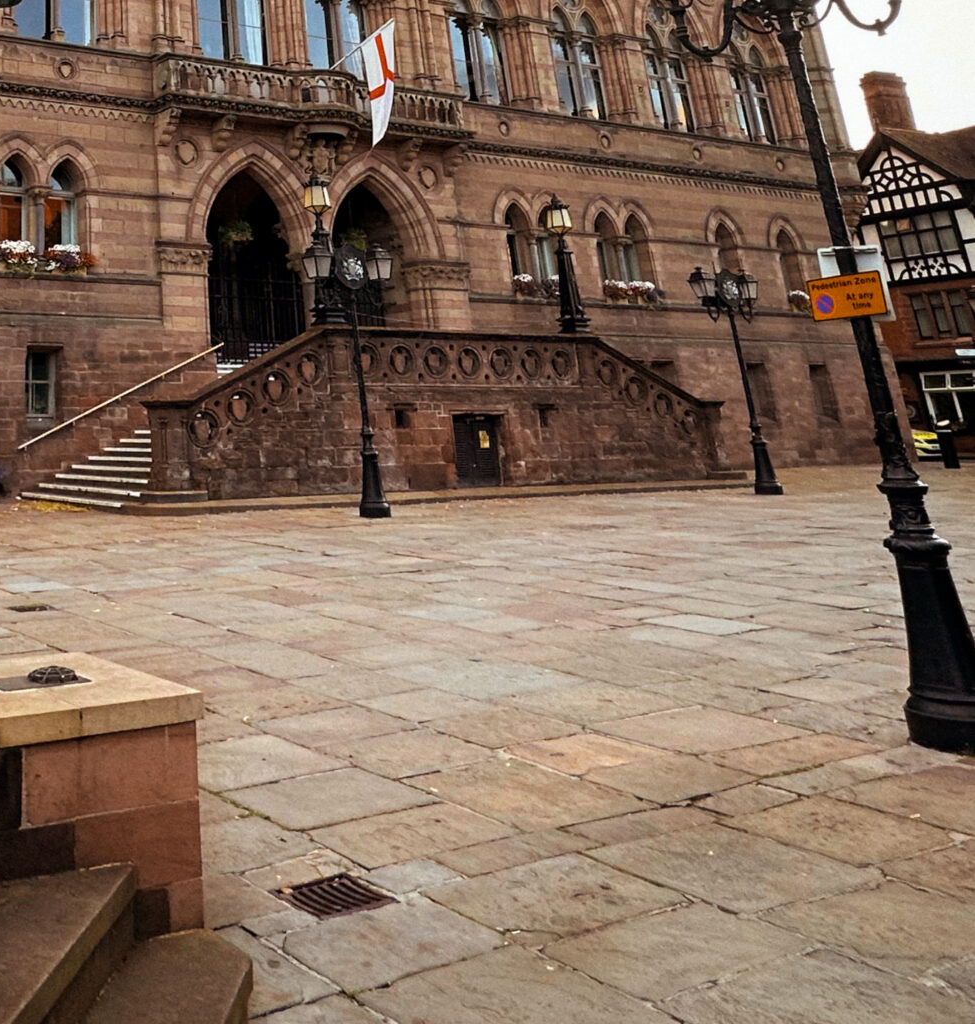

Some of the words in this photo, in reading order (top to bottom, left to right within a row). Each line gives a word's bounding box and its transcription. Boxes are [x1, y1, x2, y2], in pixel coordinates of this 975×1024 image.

[811, 279, 853, 291] Pedestrian
[854, 277, 877, 285] Zone
[846, 293, 855, 301] At
[858, 292, 874, 301] any
[852, 302, 872, 310] time
